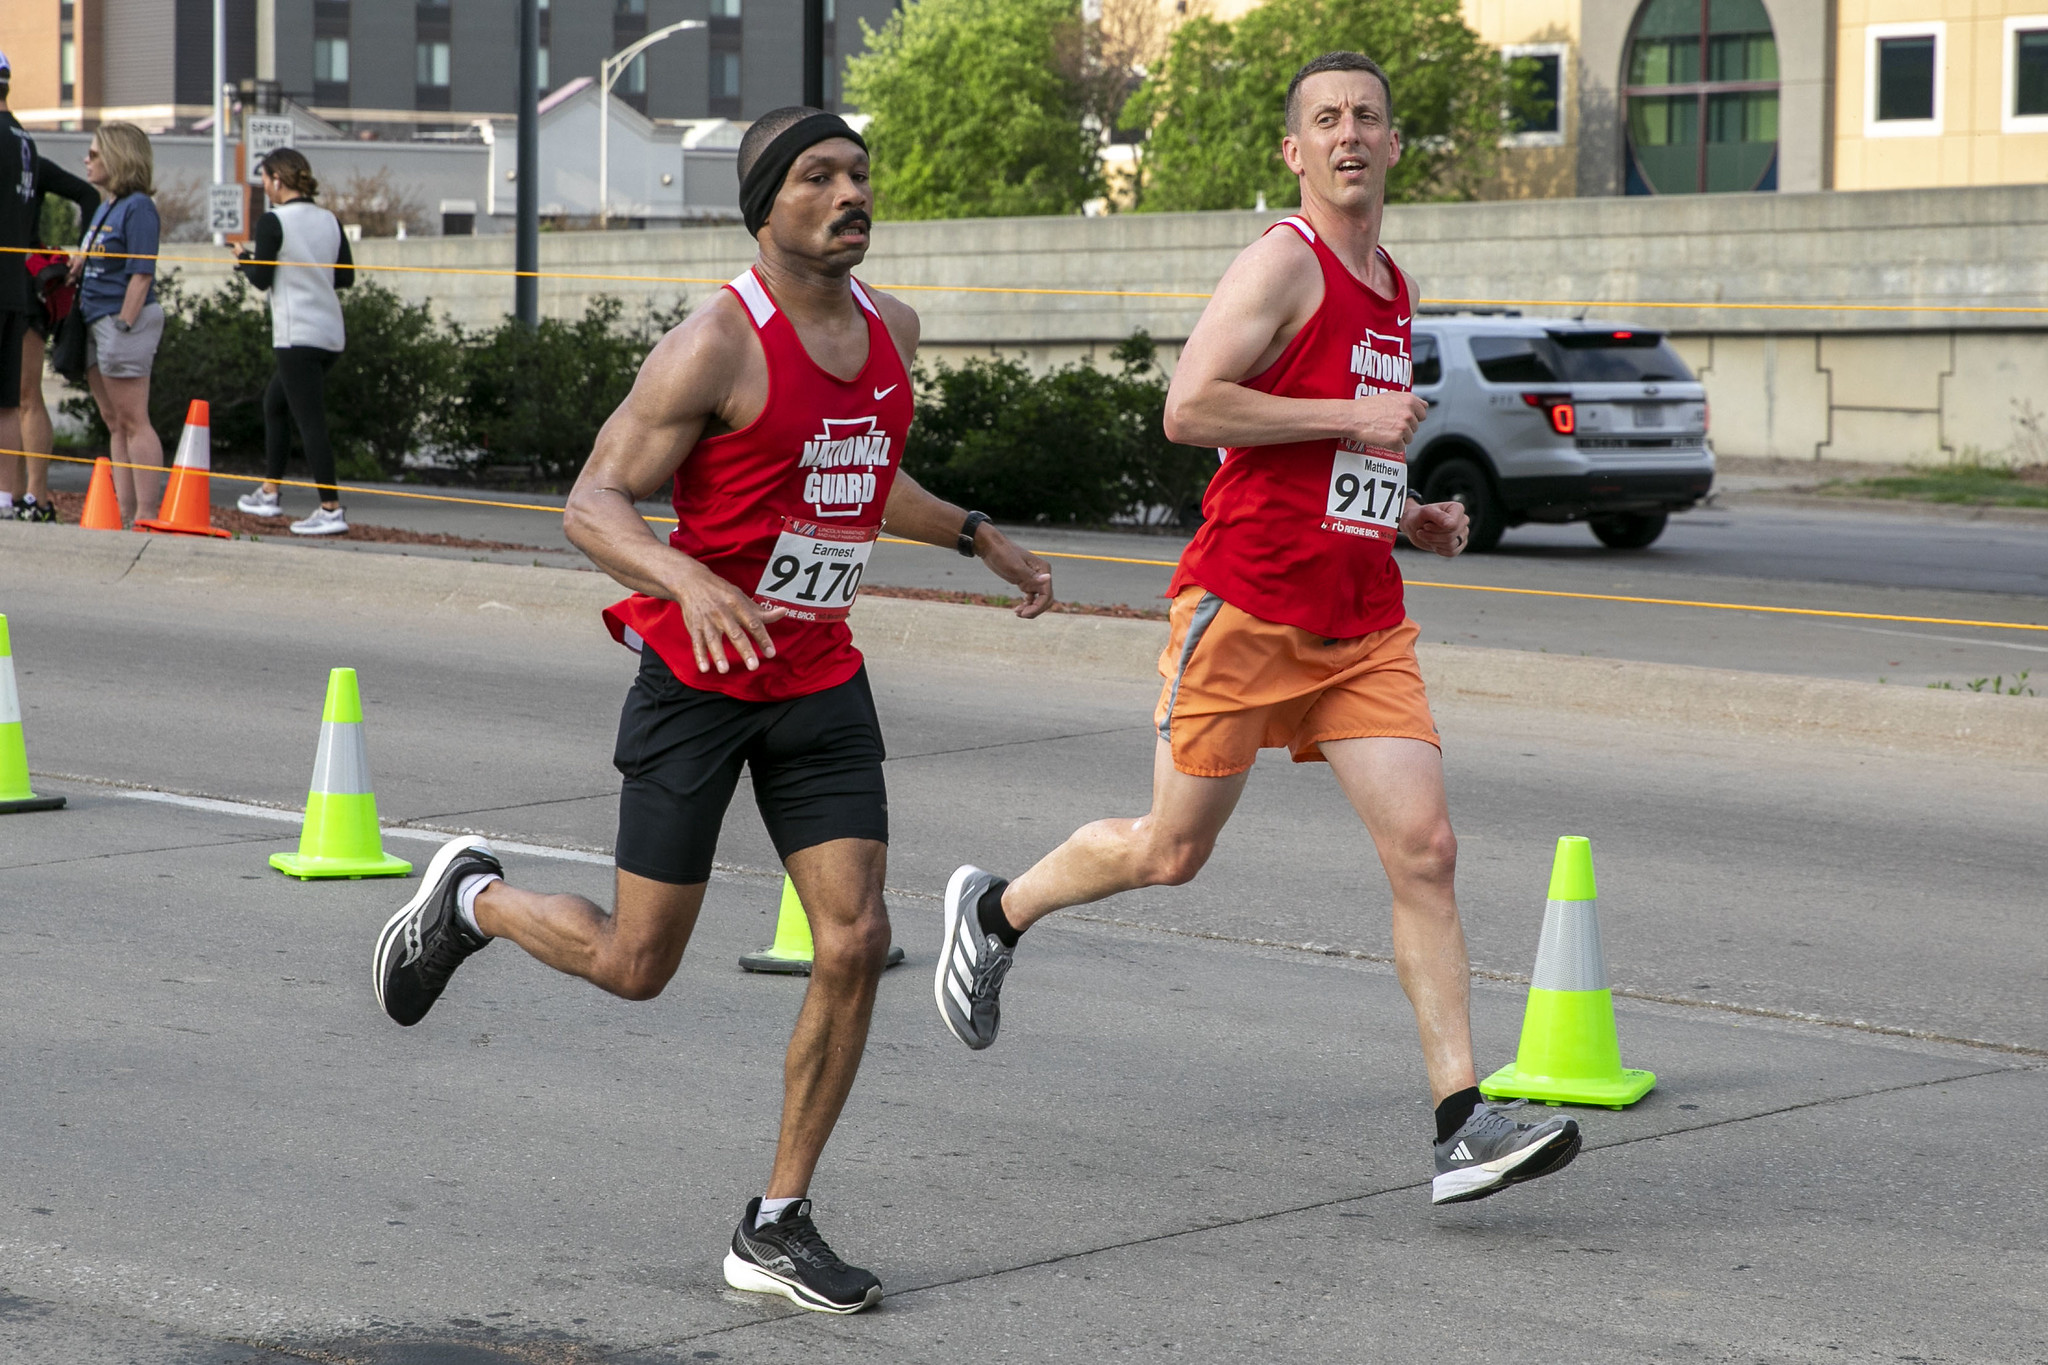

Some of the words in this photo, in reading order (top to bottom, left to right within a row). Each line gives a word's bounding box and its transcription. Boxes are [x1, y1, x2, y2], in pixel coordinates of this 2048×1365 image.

[252, 123, 290, 134] SPEED
[255, 139, 285, 147] LIMIT
[213, 209, 239, 228] 25
[798, 436, 891, 469] NATIONAL
[1364, 459, 1399, 476] Matthew
[803, 472, 876, 505] GUARD
[1334, 473, 1405, 524] 9171
[1332, 520, 1344, 531] rb
[812, 543, 855, 558] Earnest
[764, 555, 864, 602] 9170
